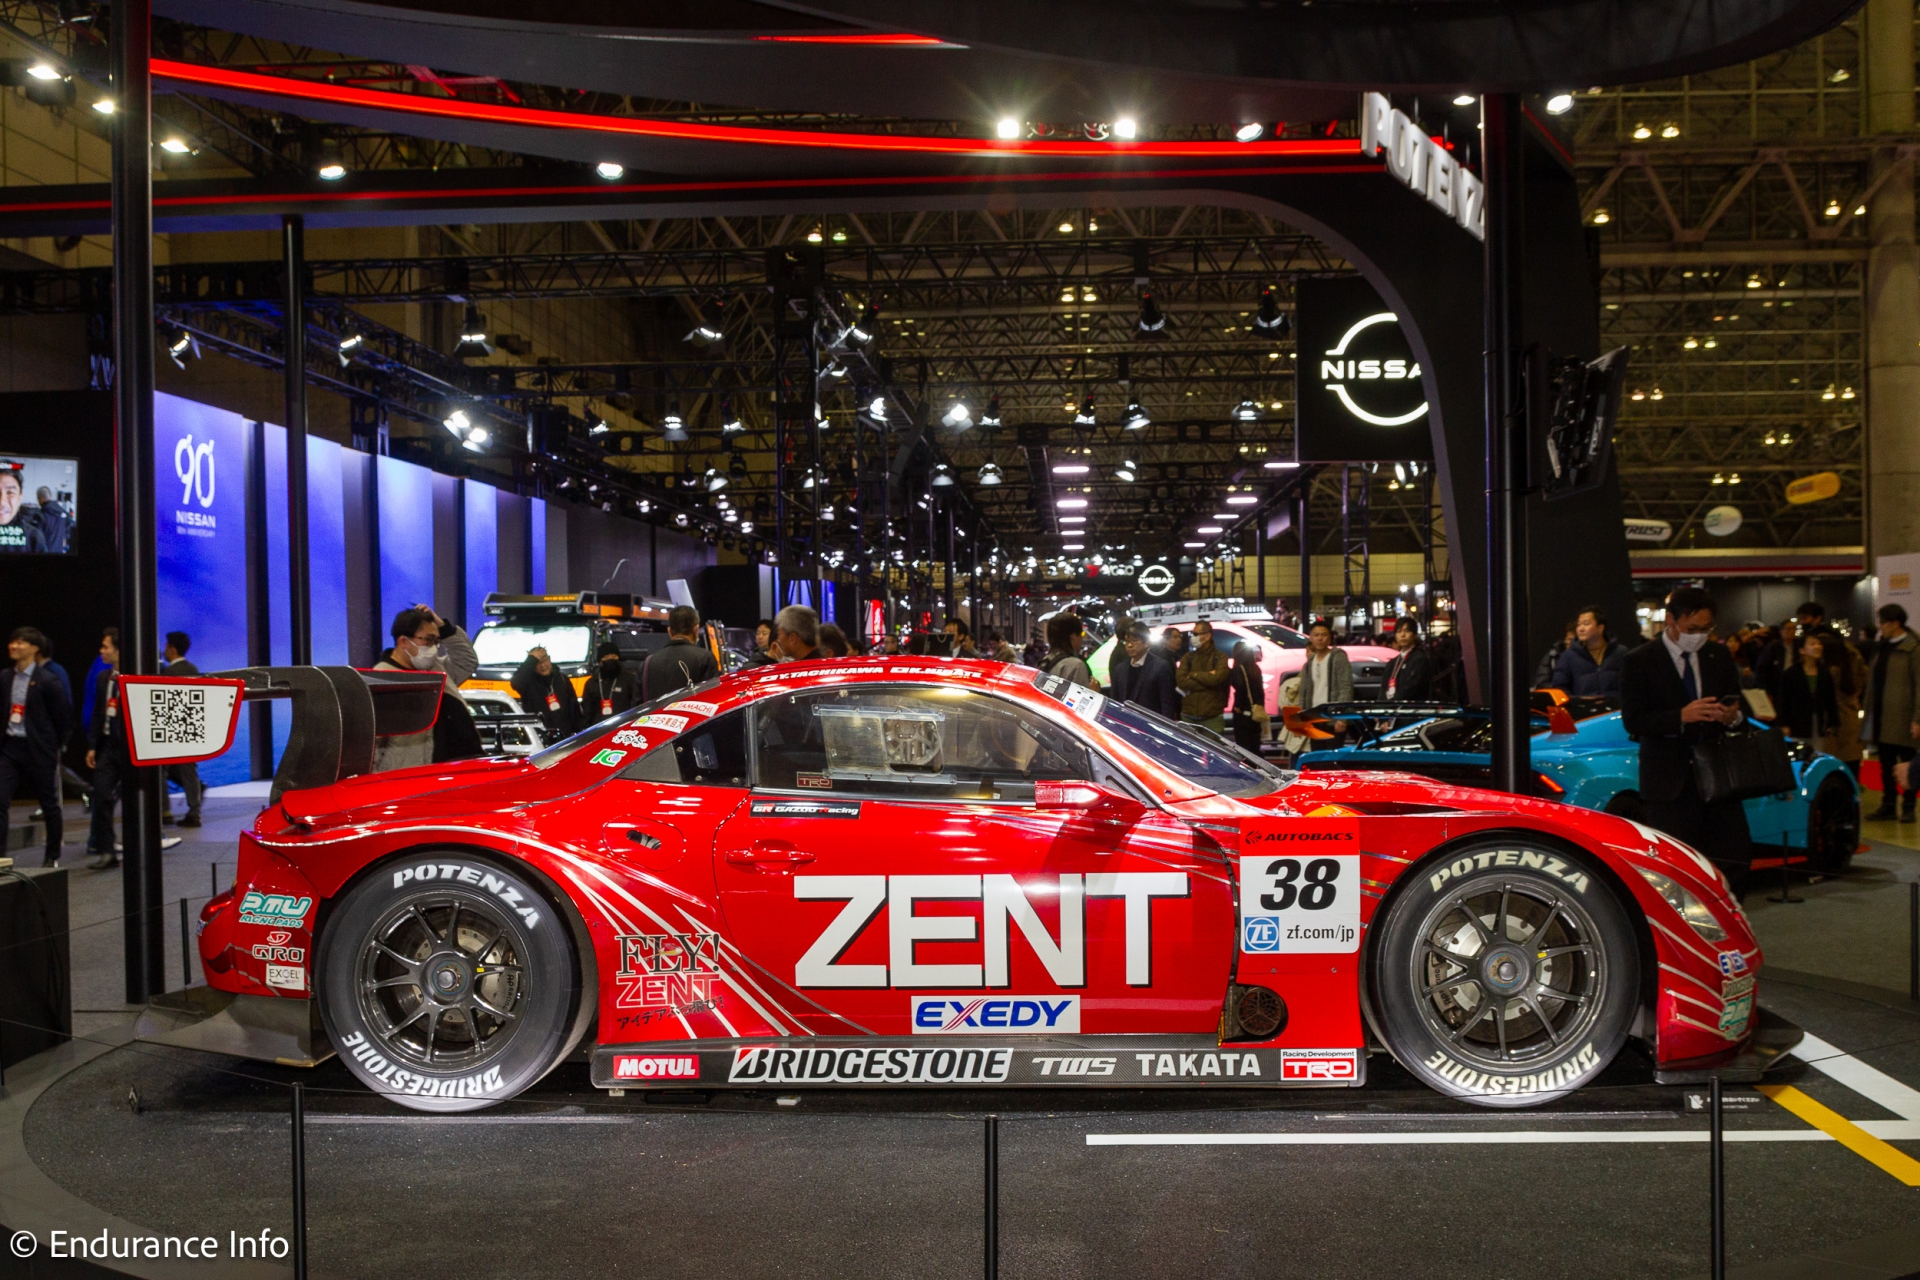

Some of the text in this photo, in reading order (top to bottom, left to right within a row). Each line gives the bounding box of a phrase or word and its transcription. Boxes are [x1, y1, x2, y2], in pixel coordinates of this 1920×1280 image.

[1360, 91, 1485, 243] POTENZ
[1321, 360, 1422, 380] NISSA
[175, 434, 215, 508] 90
[176, 510, 216, 529] NISSAN
[1138, 577, 1175, 585] NISSAN
[678, 701, 714, 714] TAMACHI
[798, 777, 831, 788] TRD
[752, 803, 775, 813] GR
[818, 806, 859, 816] Racing
[1263, 832, 1354, 842] AUTOBACS
[1430, 850, 1592, 893] POTENZA
[1260, 858, 1341, 911] 38
[393, 864, 540, 930] POTENZA
[275, 917, 304, 928] PADS
[794, 872, 1191, 988] ZENT
[1249, 922, 1354, 945] ZF zf.com/jp
[615, 933, 720, 975] FLY!
[269, 968, 300, 980] EXCEL
[616, 973, 721, 1008] ZENT
[915, 999, 1072, 1031] EXEDY
[342, 1030, 504, 1099] BRIDGESTONE
[616, 1057, 696, 1077] MOTUL
[732, 1048, 1010, 1082] BRIDGESTONE
[1031, 1057, 1118, 1076] TWS
[1135, 1053, 1261, 1077] TAKATA
[1285, 1061, 1353, 1079] TRD
[1424, 1042, 1601, 1098] BRIDGESTONE
